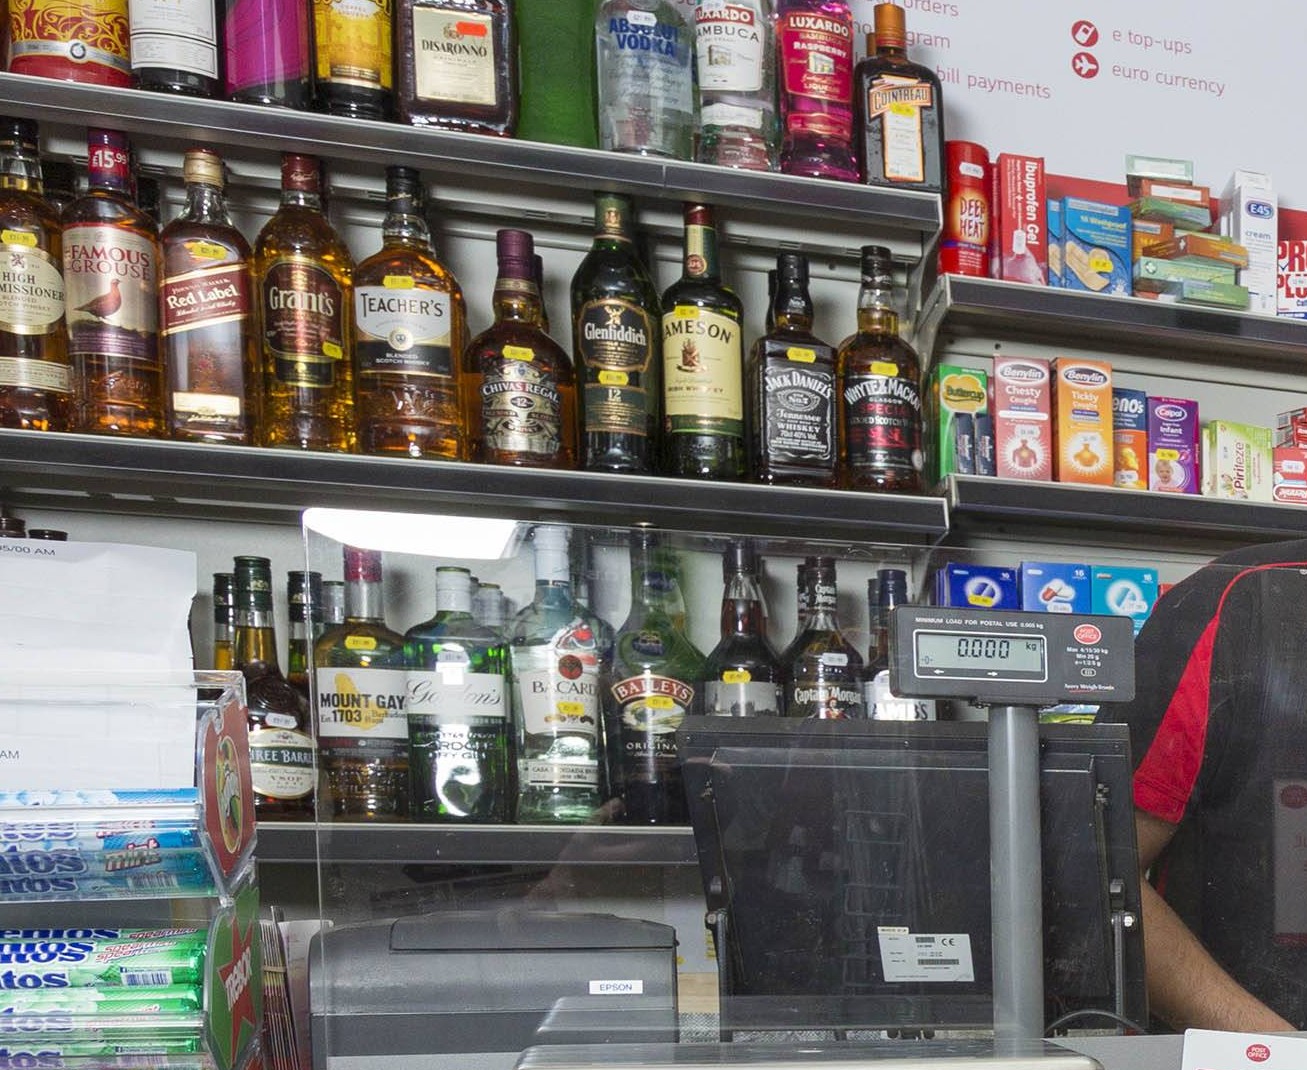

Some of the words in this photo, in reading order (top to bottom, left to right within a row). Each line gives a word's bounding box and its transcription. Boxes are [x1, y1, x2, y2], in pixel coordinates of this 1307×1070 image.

[789, 16, 849, 37] LUXARDO
[421, 38, 488, 58] DISARONNO
[616, 33, 675, 57] VODKA
[793, 42, 847, 58] RASPBERRY
[1113, 30, 1122, 42] e
[1128, 30, 1192, 55] top-ups
[936, 66, 960, 84] bill
[967, 73, 1051, 99] payments
[1112, 64, 1149, 82] euro
[1155, 70, 1225, 96] currency
[874, 87, 928, 110] COINTREAU
[92, 150, 128, 169] £15.99
[1025, 161, 1038, 221] Ibuprofen
[1250, 205, 1270, 215] E45
[960, 219, 985, 236] HEAT
[1026, 223, 1039, 245] Gel
[1246, 231, 1271, 240] cream
[72, 245, 149, 268] FAMOUS
[3, 272, 35, 284] HIGH
[71, 260, 150, 281] GROUSE
[167, 294, 194, 310] Red
[200, 285, 239, 304] Label
[270, 286, 335, 317] Grant's
[360, 293, 444, 318] TEACHER'S
[585, 322, 646, 347] Glenfiddich
[1004, 368, 1044, 379] Benylin
[1066, 369, 1105, 383] Benylin
[483, 382, 523, 396] CHIVAS
[527, 382, 558, 401] REGAL
[607, 389, 621, 401] 12
[765, 373, 792, 391] JACK
[792, 372, 834, 399] DANIEL'S
[946, 386, 985, 402] Buttercup
[1006, 386, 1041, 399] Chesty
[1009, 396, 1037, 405] Coughs
[1072, 391, 1099, 402] Tickly
[776, 408, 822, 422] Tennessee
[1158, 408, 1183, 418] Calpol
[777, 422, 821, 433] WHISKEY
[1159, 426, 1182, 435] Infant
[1233, 442, 1245, 490] Piriteze
[34, 547, 56, 556] AM
[957, 638, 1010, 659] 0.000
[1026, 642, 1037, 651] kg
[618, 679, 688, 699] BAILEYS
[320, 693, 372, 708] MOUNT
[376, 694, 405, 710] GAY
[332, 710, 361, 723] 1703
[600, 983, 633, 992] EPSON
